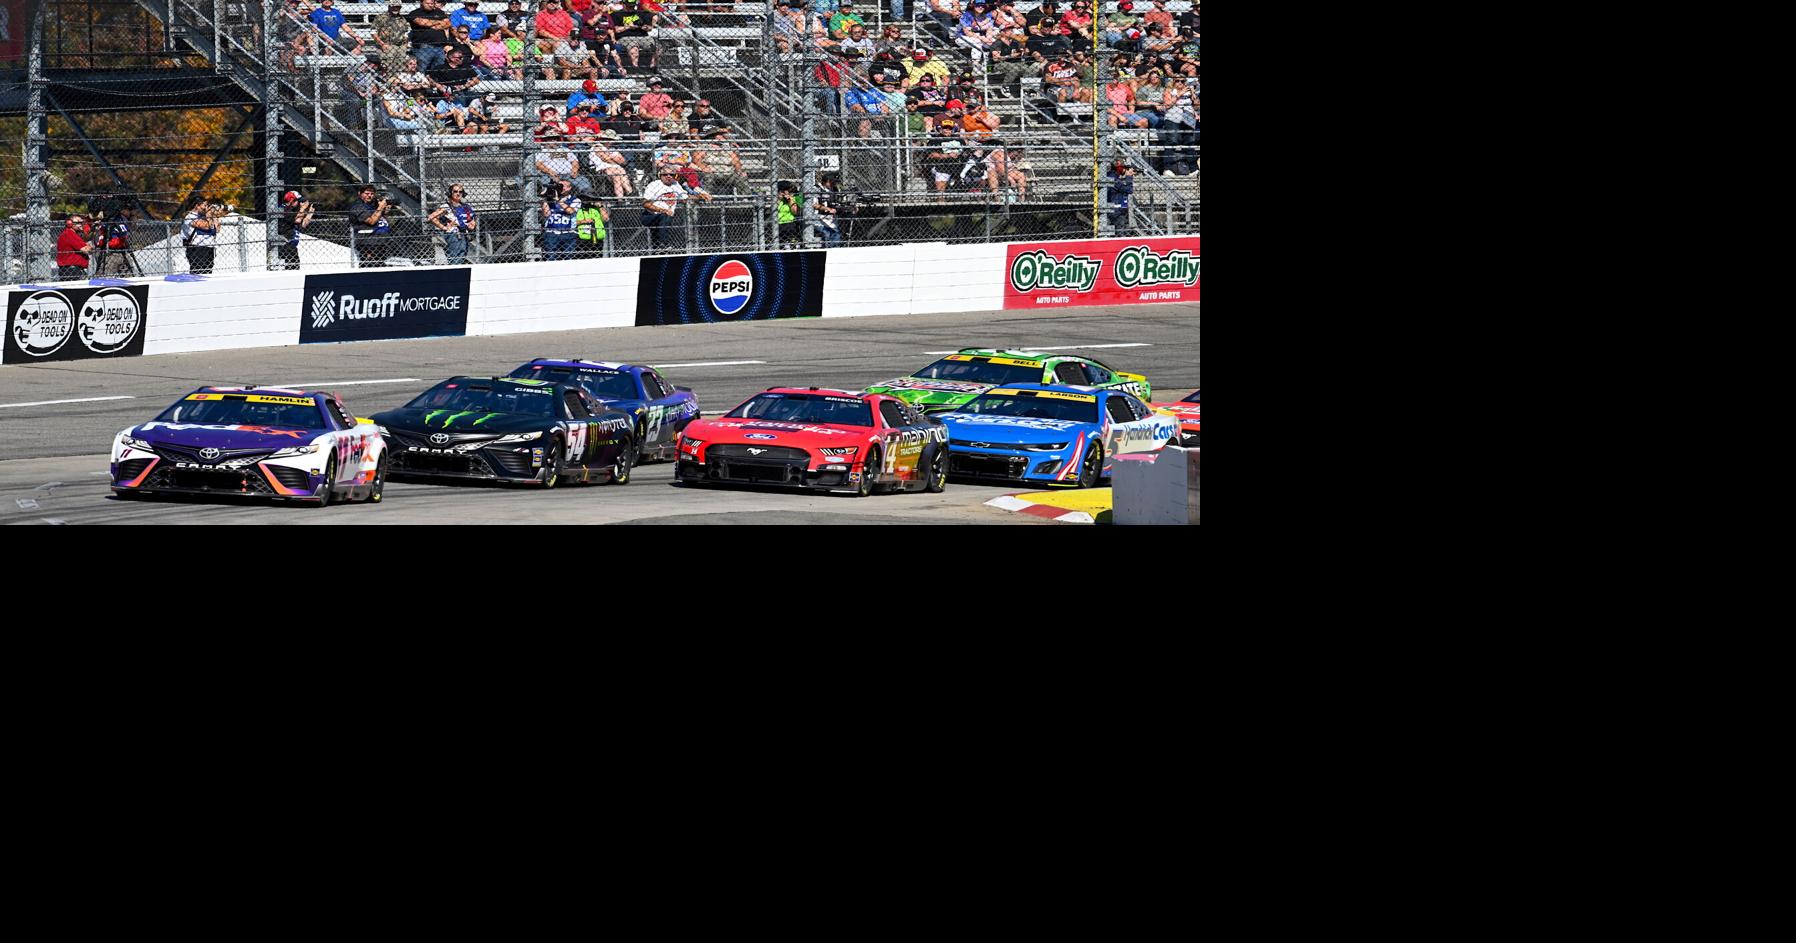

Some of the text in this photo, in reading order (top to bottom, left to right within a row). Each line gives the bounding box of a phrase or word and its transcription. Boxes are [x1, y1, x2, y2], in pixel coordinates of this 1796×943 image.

[1013, 250, 1096, 289] O'Reilly
[712, 281, 750, 293] PEPSI
[1051, 296, 1069, 304] PARTS
[1139, 291, 1181, 300] AUTO PARTS
[339, 292, 461, 320] Ruoff MORTGAGE
[41, 309, 68, 324] DEAD ON
[106, 307, 134, 321] DEAD ON
[40, 325, 66, 338] TOOLS
[105, 322, 131, 335] TOOLS
[579, 367, 620, 375] WALLACE
[514, 386, 549, 396] GIBBS
[1049, 391, 1088, 400] LARSON
[259, 395, 310, 405] HAMLIN
[824, 396, 863, 404] BRISCOE
[566, 424, 587, 462] 54
